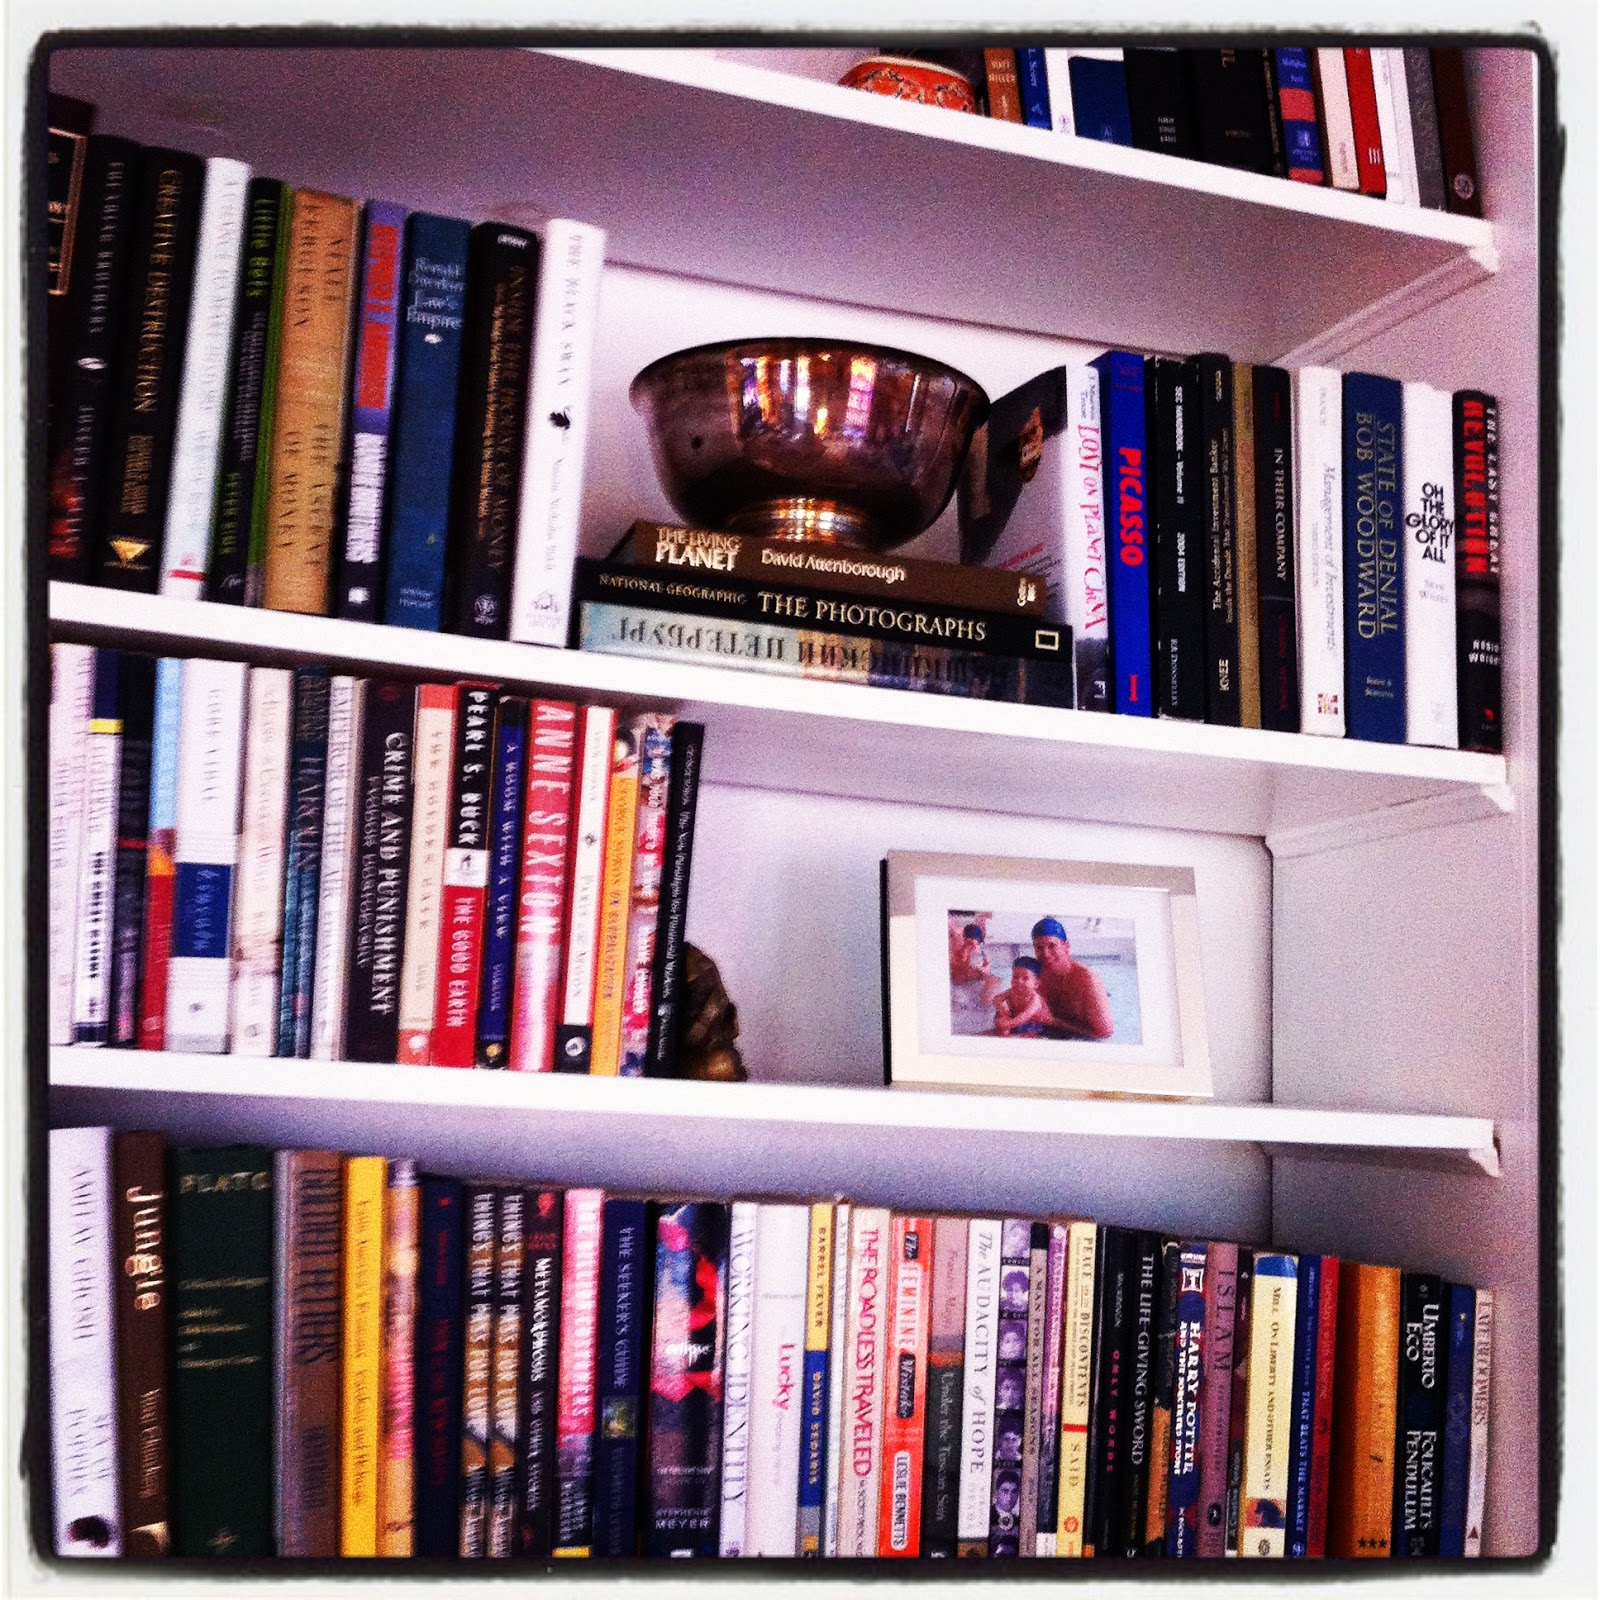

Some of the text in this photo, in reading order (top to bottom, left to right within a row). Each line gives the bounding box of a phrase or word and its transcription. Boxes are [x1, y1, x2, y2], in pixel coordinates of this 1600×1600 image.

[150, 170, 184, 265] CREATIVE
[132, 270, 173, 413] DESTRUCTION
[1118, 446, 1144, 566] PICASSO
[1273, 448, 1287, 580] IN THEIR COMPANY
[1323, 463, 1337, 550] Management
[1420, 498, 1444, 516] THE
[1422, 482, 1443, 502] OH
[1462, 399, 1487, 573] REVOLUTION
[1487, 454, 1498, 502] LAST
[654, 542, 738, 572] PLANET
[657, 526, 742, 550] THE LIVING
[1176, 532, 1187, 593] 2004 EDITION
[1355, 411, 1376, 640] BOB WOODWARD
[1376, 420, 1398, 636] STATE OF DENIAL
[1405, 513, 1454, 535] GLORY
[1415, 529, 1449, 549] OF IT
[1422, 546, 1446, 564] ALL
[599, 573, 748, 604] NATIONAL GEOGRAPHIC
[761, 548, 907, 584] David Attenborough
[1212, 590, 1223, 609] The
[757, 590, 987, 642] THE PHOTOGRAPHS
[1219, 659, 1230, 691] KNEE
[464, 691, 490, 752] PEARL
[457, 792, 482, 845] BUCK
[519, 704, 574, 936] ANNE SEXTON
[369, 732, 407, 1015] CRIME AND PUNISHMENT
[446, 897, 474, 1028] THE GOOD EARTH
[179, 1171, 272, 1195] PLATO
[125, 1186, 165, 1311] Jungle
[813, 1227, 827, 1329] BARREL FEVER
[860, 1229, 880, 1265] THE
[465, 1193, 494, 1436] THINGS THAT PASS FOR LOVE
[494, 1193, 523, 1436] THINGS THAT PASS FOR LOVE
[530, 1257, 552, 1382] METAMORPHOSIS
[613, 1226, 635, 1389] THE SEEKER'S GUIDE
[898, 1231, 919, 1419] The FEMININE Mistake
[1031, 1318, 1042, 1348] FOR
[1033, 1280, 1043, 1312] MAN
[1076, 1237, 1093, 1408] PEACE DISCONTENTS
[1179, 1321, 1188, 1348] AND
[1213, 1269, 1236, 1372] ISLAM
[1269, 1320, 1281, 1339] ON
[1270, 1286, 1282, 1314] MILL
[665, 1342, 712, 1366] eclipse
[722, 1229, 754, 1512] WORKING IDENTITY
[772, 1343, 796, 1410] Lucky
[967, 1231, 993, 1475] The AUDACITY of HOPE
[1030, 1353, 1040, 1381] ALL
[1129, 1254, 1155, 1465] THE LIFE-GIVING SWORD
[1177, 1351, 1186, 1374] THE
[1267, 1341, 1279, 1388] LIBERTY
[1405, 1322, 1420, 1361] ECO
[1421, 1303, 1439, 1389] UMBERTO
[808, 1371, 822, 1486] DAVID SEDARIS
[852, 1372, 874, 1477] TRAVELED
[1028, 1386, 1039, 1456] SEASONS
[1106, 1350, 1121, 1473] ONLY WORDS
[1183, 1320, 1201, 1474] HARRY POTTER
[936, 1371, 954, 1520] Under the Tuscan Sun
[1068, 1442, 1081, 1488] SAID
[1174, 1439, 1183, 1476] STONE
[1295, 1391, 1311, 1532] THAT BEATS THE MARKET
[1403, 1430, 1420, 1530] PENDULUM
[1419, 1430, 1437, 1530] FOUCAULT'S
[655, 1519, 711, 1531] MEYER
[893, 1456, 908, 1546] LESLIE BENNETTS
